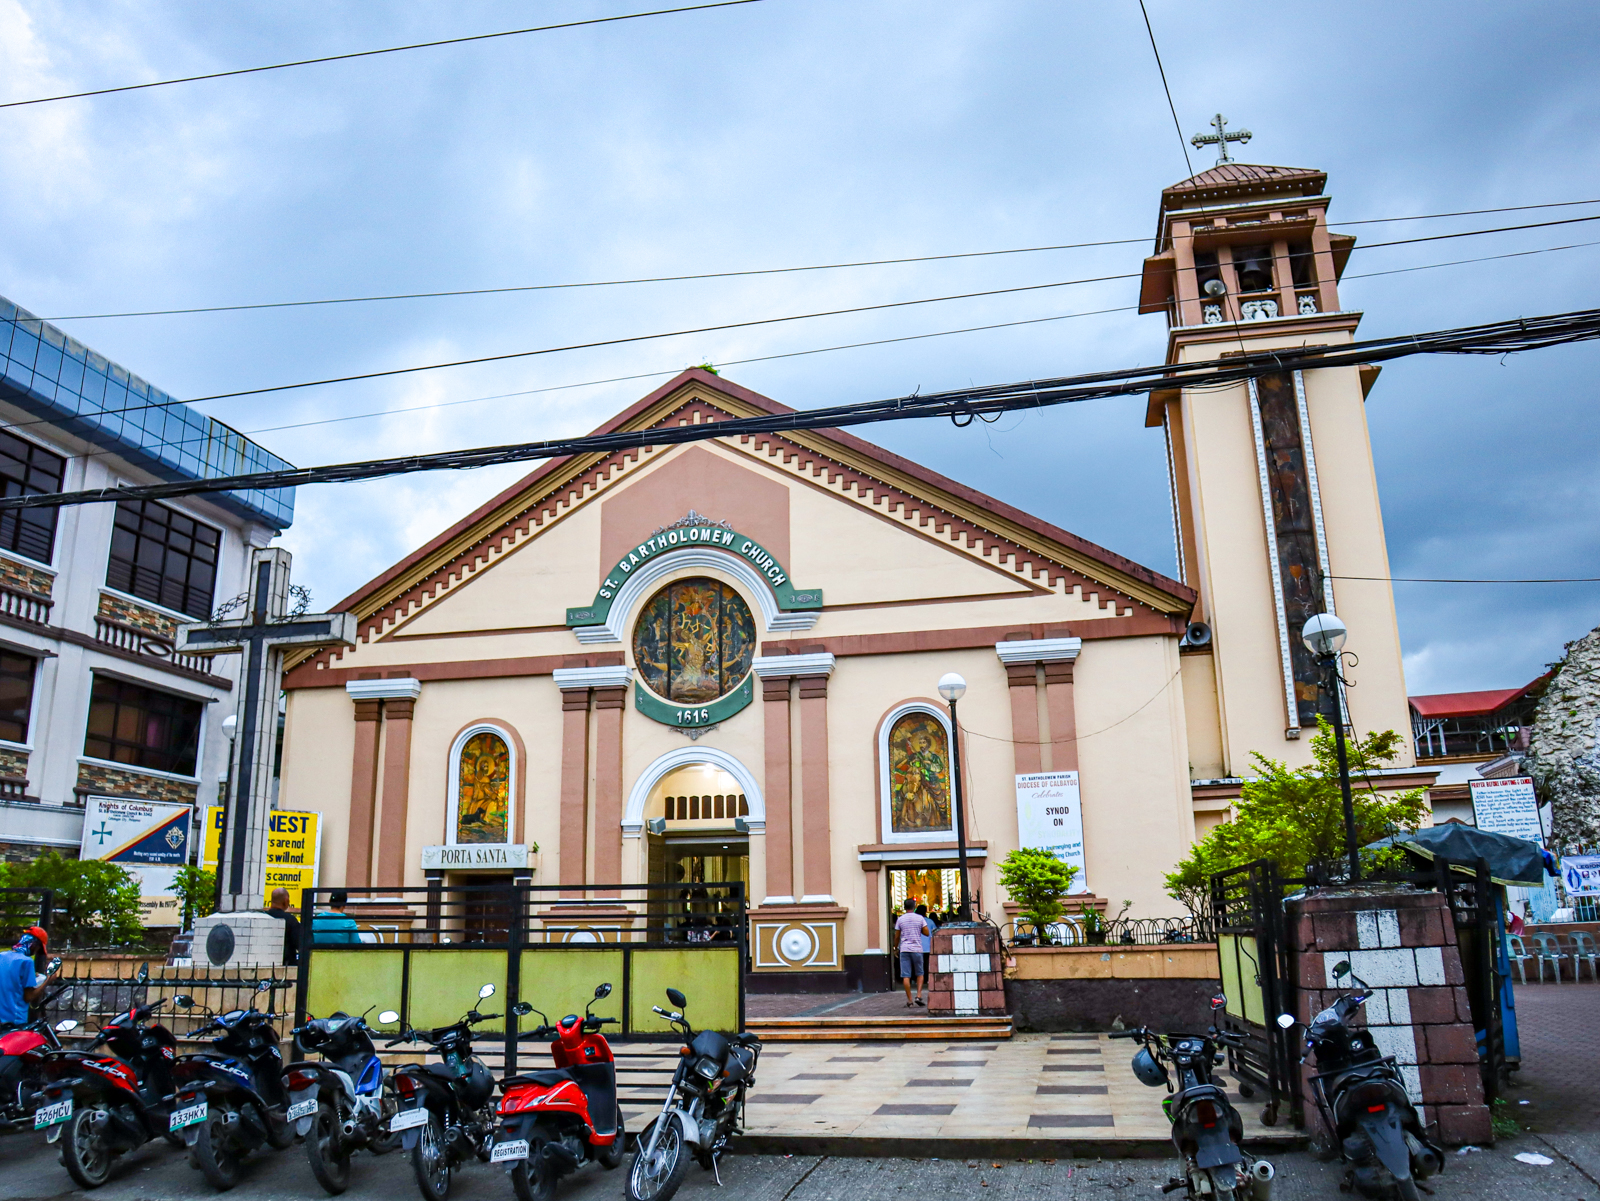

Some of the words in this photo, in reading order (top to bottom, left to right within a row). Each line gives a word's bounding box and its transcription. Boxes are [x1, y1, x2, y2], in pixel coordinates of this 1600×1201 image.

[600, 579, 619, 600] ST.
[620, 528, 735, 573] BARTHOLOMEW
[741, 541, 786, 587] CHURCH
[677, 709, 709, 724] 1616
[1032, 790, 1064, 799] Celebrates
[1046, 807, 1069, 815] SYNOD
[277, 839, 290, 848] are
[292, 838, 304, 848] not
[275, 852, 290, 862] will
[291, 853, 304, 863] not
[441, 850, 472, 863] PORTA
[476, 849, 507, 863] SANTA
[273, 871, 301, 882] cannot
[82, 1059, 127, 1080] CLICK
[208, 1060, 249, 1080] CLICK
[37, 1104, 70, 1124] 326HCV
[172, 1107, 205, 1126] 133HKX
[494, 1145, 527, 1158] REGISTRATION
